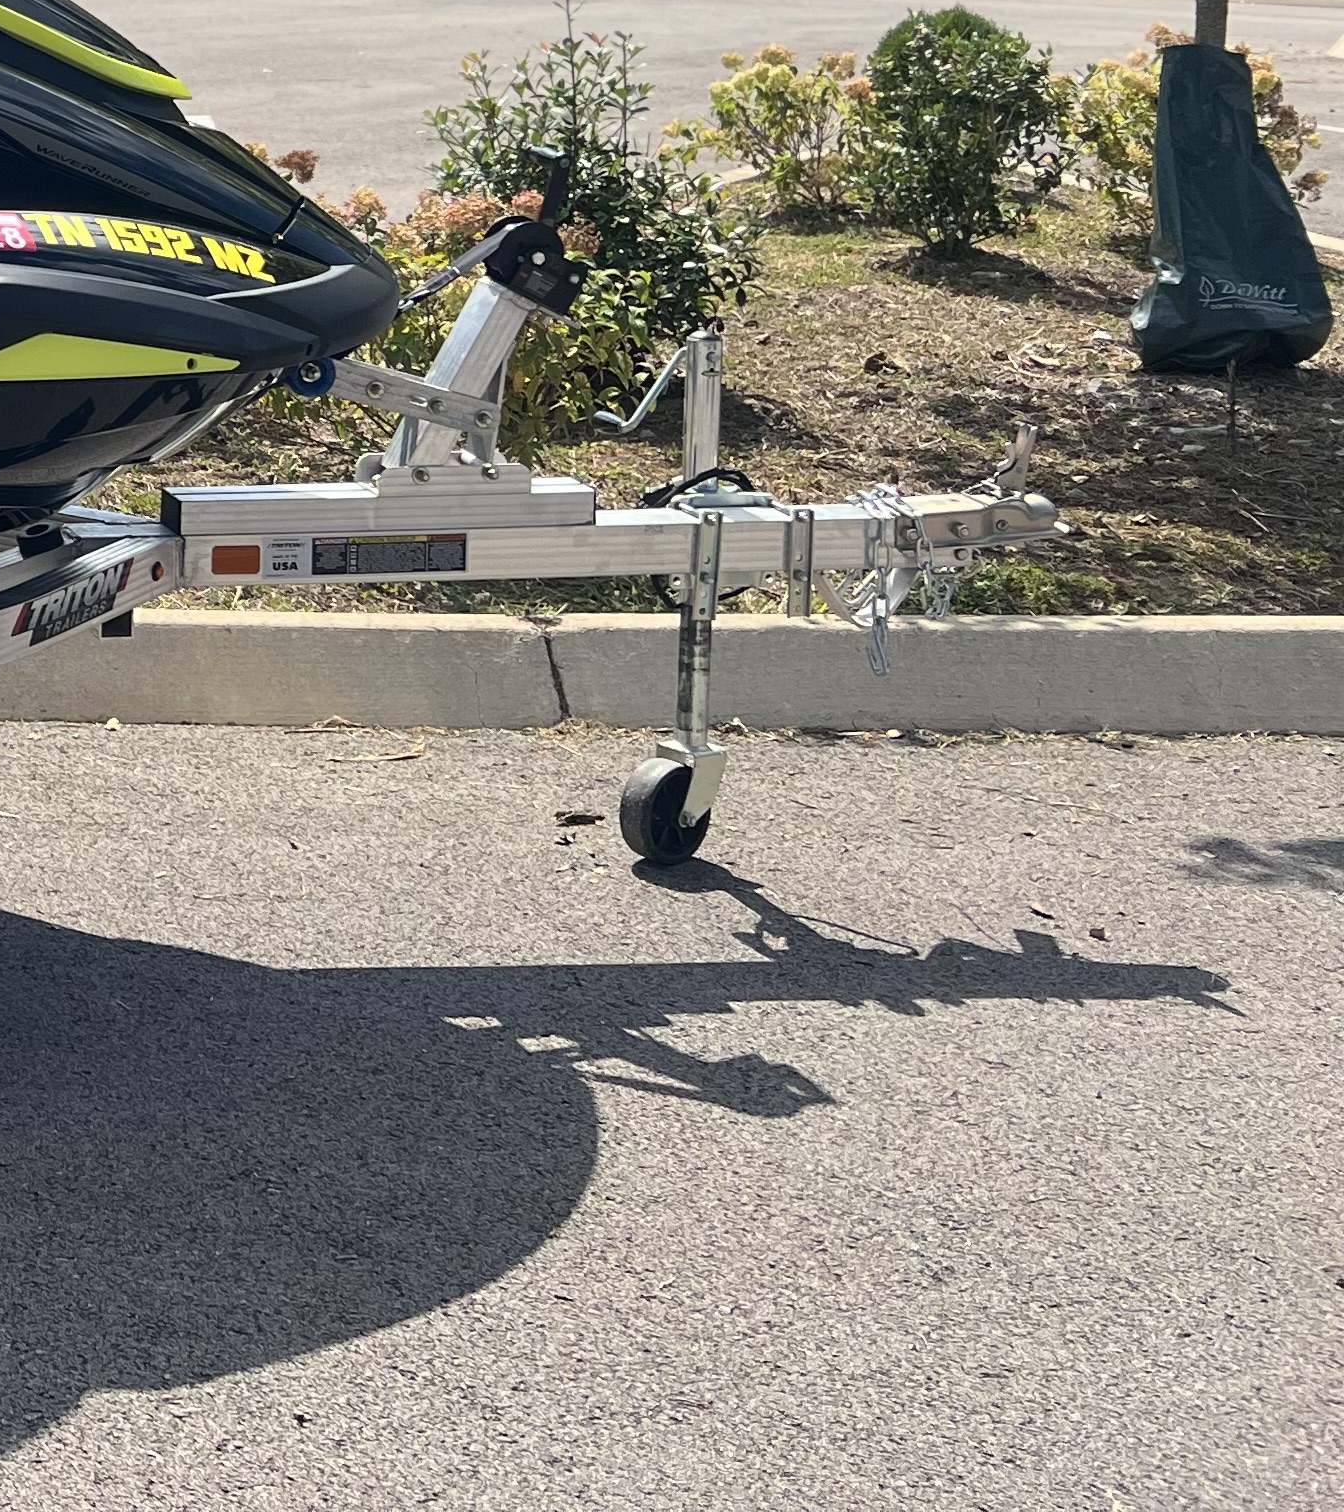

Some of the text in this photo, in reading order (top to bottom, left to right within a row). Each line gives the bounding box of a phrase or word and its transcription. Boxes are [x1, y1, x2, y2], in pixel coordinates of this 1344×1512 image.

[21, 213, 277, 284] TN 1592 MZ
[1215, 279, 1288, 301] DeWitt
[272, 561, 299, 571] USA
[27, 562, 125, 630] TRITON
[45, 599, 108, 638] TRAILERS
